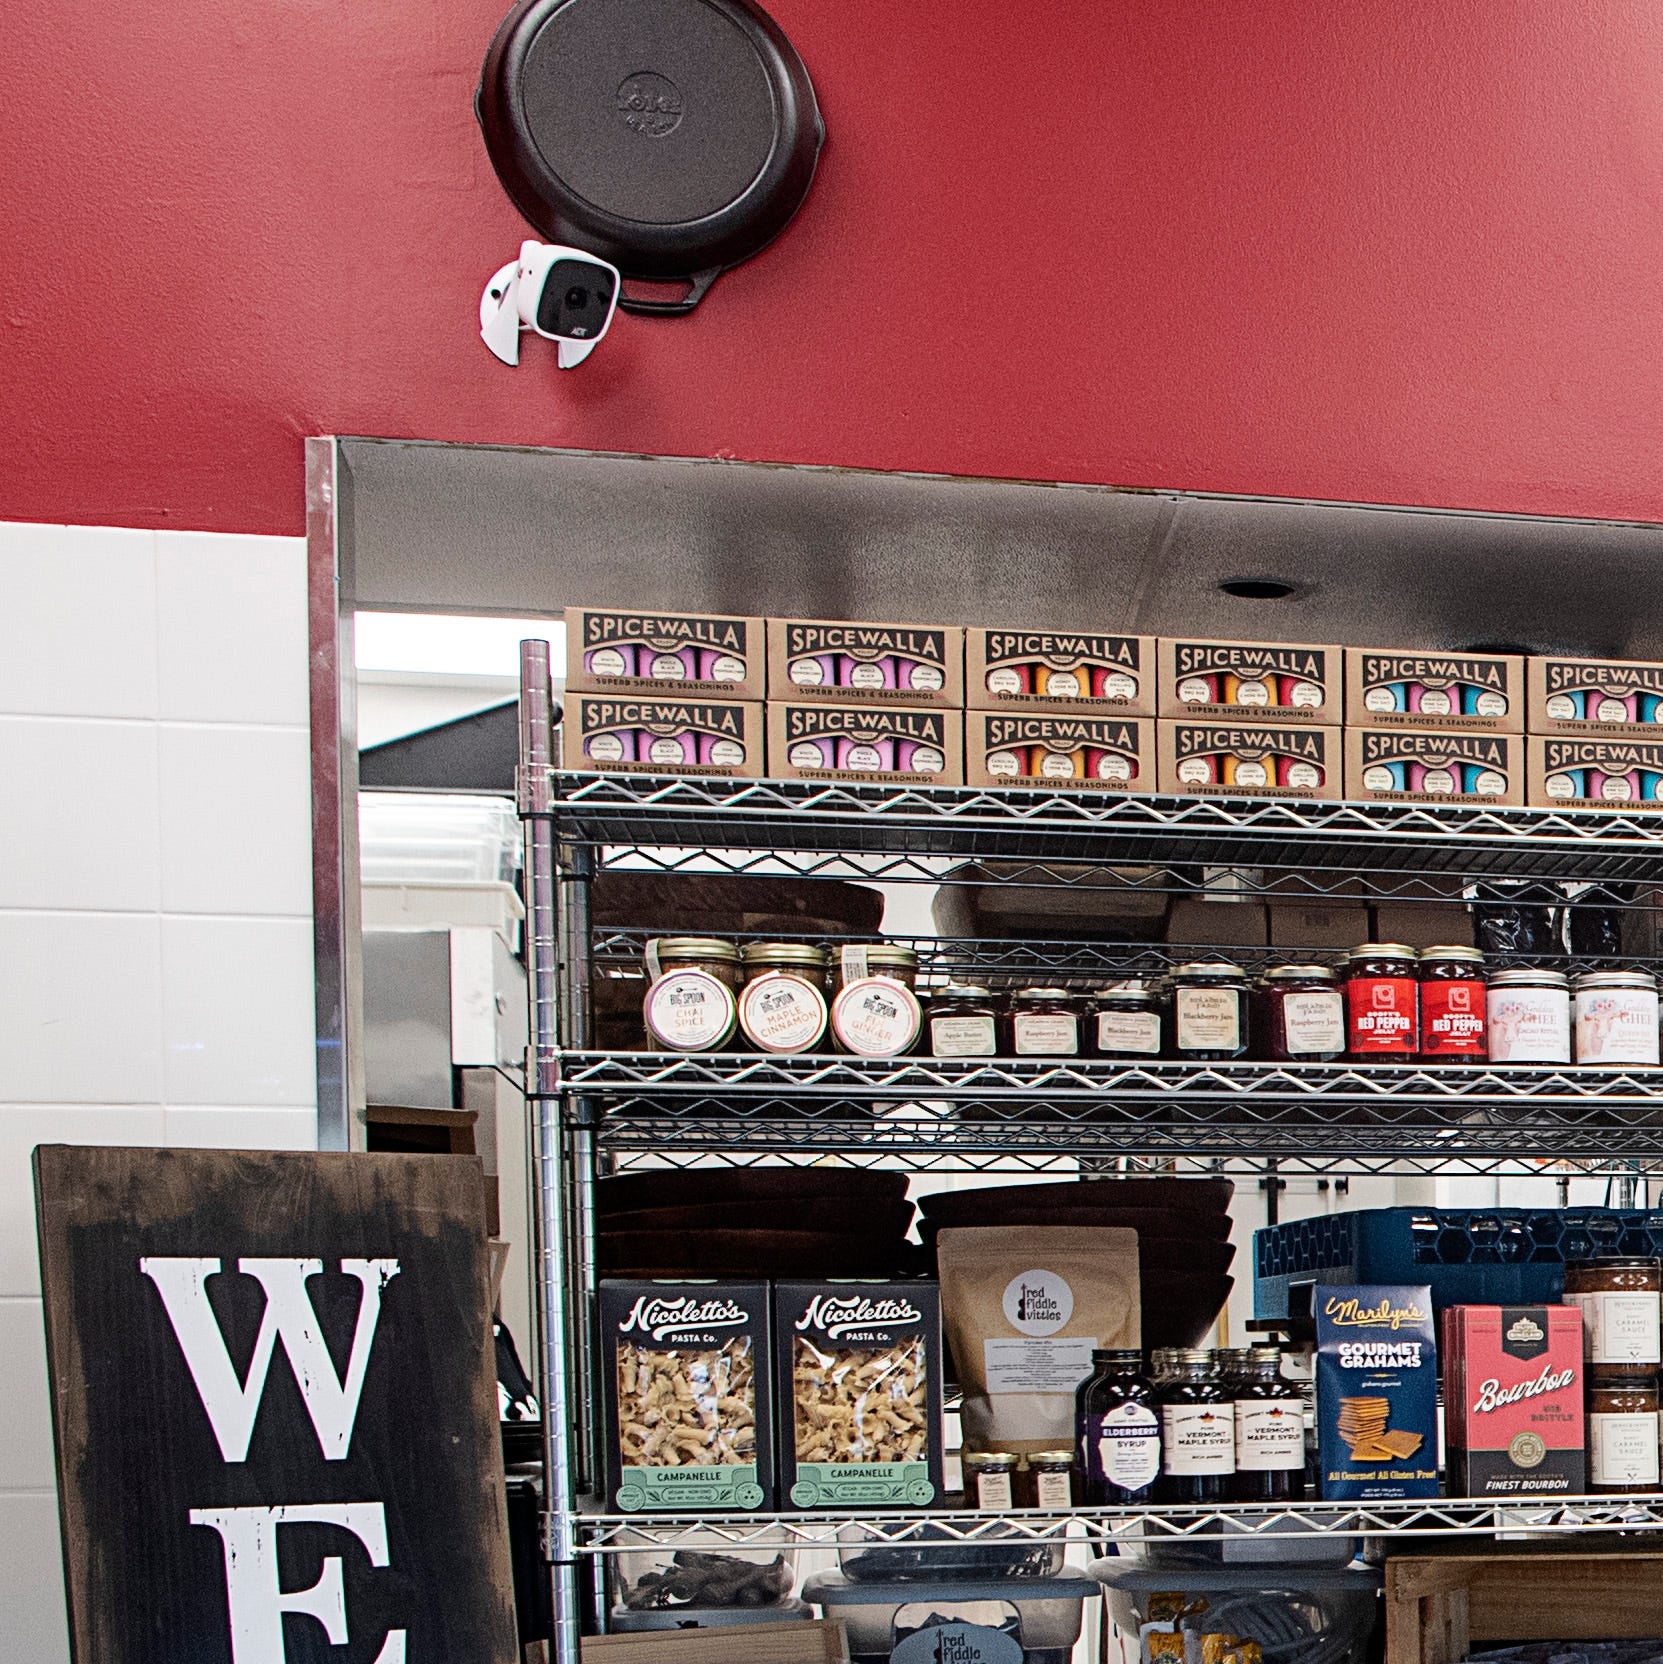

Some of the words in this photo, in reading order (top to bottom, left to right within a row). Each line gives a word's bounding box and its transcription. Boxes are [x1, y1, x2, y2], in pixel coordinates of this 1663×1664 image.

[588, 617, 740, 650] SPICEWALLA
[792, 626, 939, 660] SPICEWALLA
[991, 636, 1132, 666] SPICEWALLA
[1180, 648, 1320, 680] SPICEWALLA
[1366, 656, 1500, 686] SPICEWALLA
[586, 704, 734, 736] SPICEWALLA
[792, 710, 938, 742] SPICEWALLA
[990, 720, 1132, 750] SPICEWALLA
[1556, 722, 1588, 731] SUPERB
[1590, 724, 1616, 732] SPICES
[1180, 730, 1318, 762] SPICEWALLA
[1366, 736, 1500, 766] SPICEWALLA
[1026, 1286, 1045, 1298] red
[1026, 1298, 1057, 1310] fiddle
[620, 1296, 749, 1342] Nicoletto's
[794, 1294, 922, 1340] Nicoletto's
[1026, 1309, 1062, 1321] vittles
[1324, 1296, 1428, 1330] Marilyn's
[671, 1334, 700, 1343] PASTA
[702, 1334, 718, 1343] Co.
[846, 1332, 874, 1341] PASTA
[876, 1332, 892, 1341] Co.
[1338, 1342, 1422, 1356] GOURMET
[1340, 1355, 1422, 1368] GRAHAMS
[1474, 1364, 1574, 1412] Bourbon
[656, 1471, 722, 1482] CAMPANELLE
[830, 1468, 894, 1478] CAMPANELLE
[1485, 1480, 1518, 1490] FINEST
[1520, 1479, 1568, 1490] BOURBON
[943, 1633, 966, 1647] red
[943, 1646, 981, 1660] fiddle
